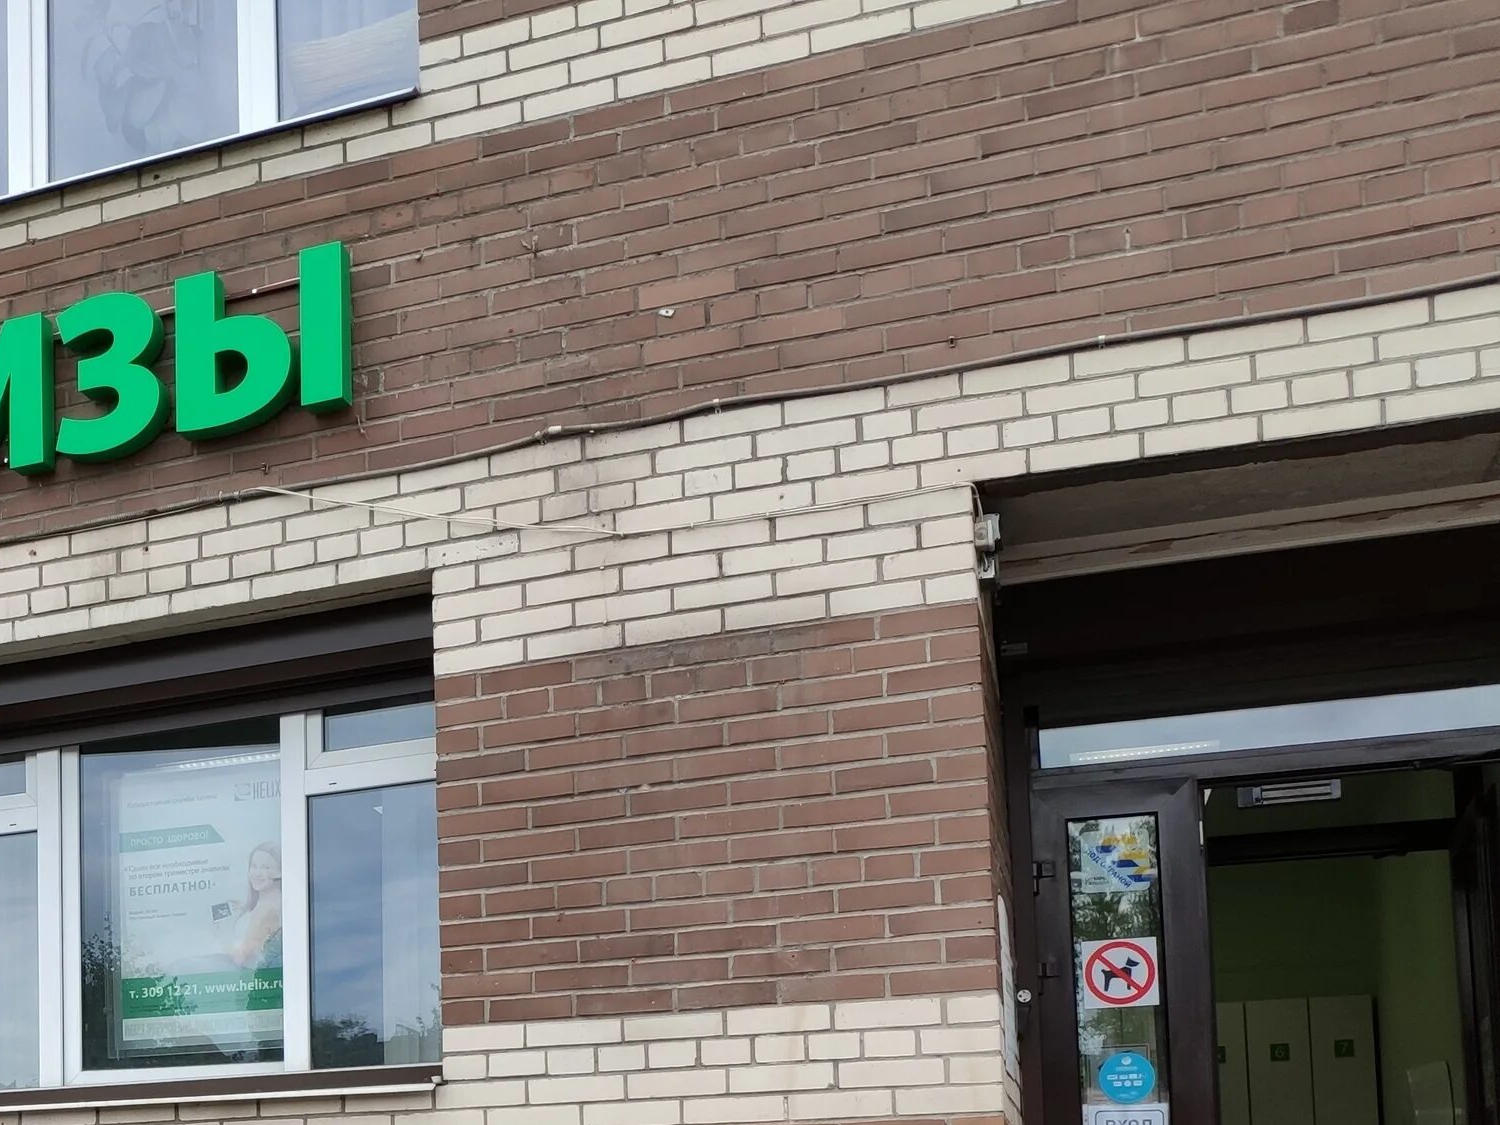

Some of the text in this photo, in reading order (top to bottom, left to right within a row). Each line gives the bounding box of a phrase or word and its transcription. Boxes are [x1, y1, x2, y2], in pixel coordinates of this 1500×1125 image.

[253, 780, 281, 800] HELIX
[141, 986, 164, 998] 309
[167, 984, 181, 997] 12
[184, 983, 202, 996] 21,
